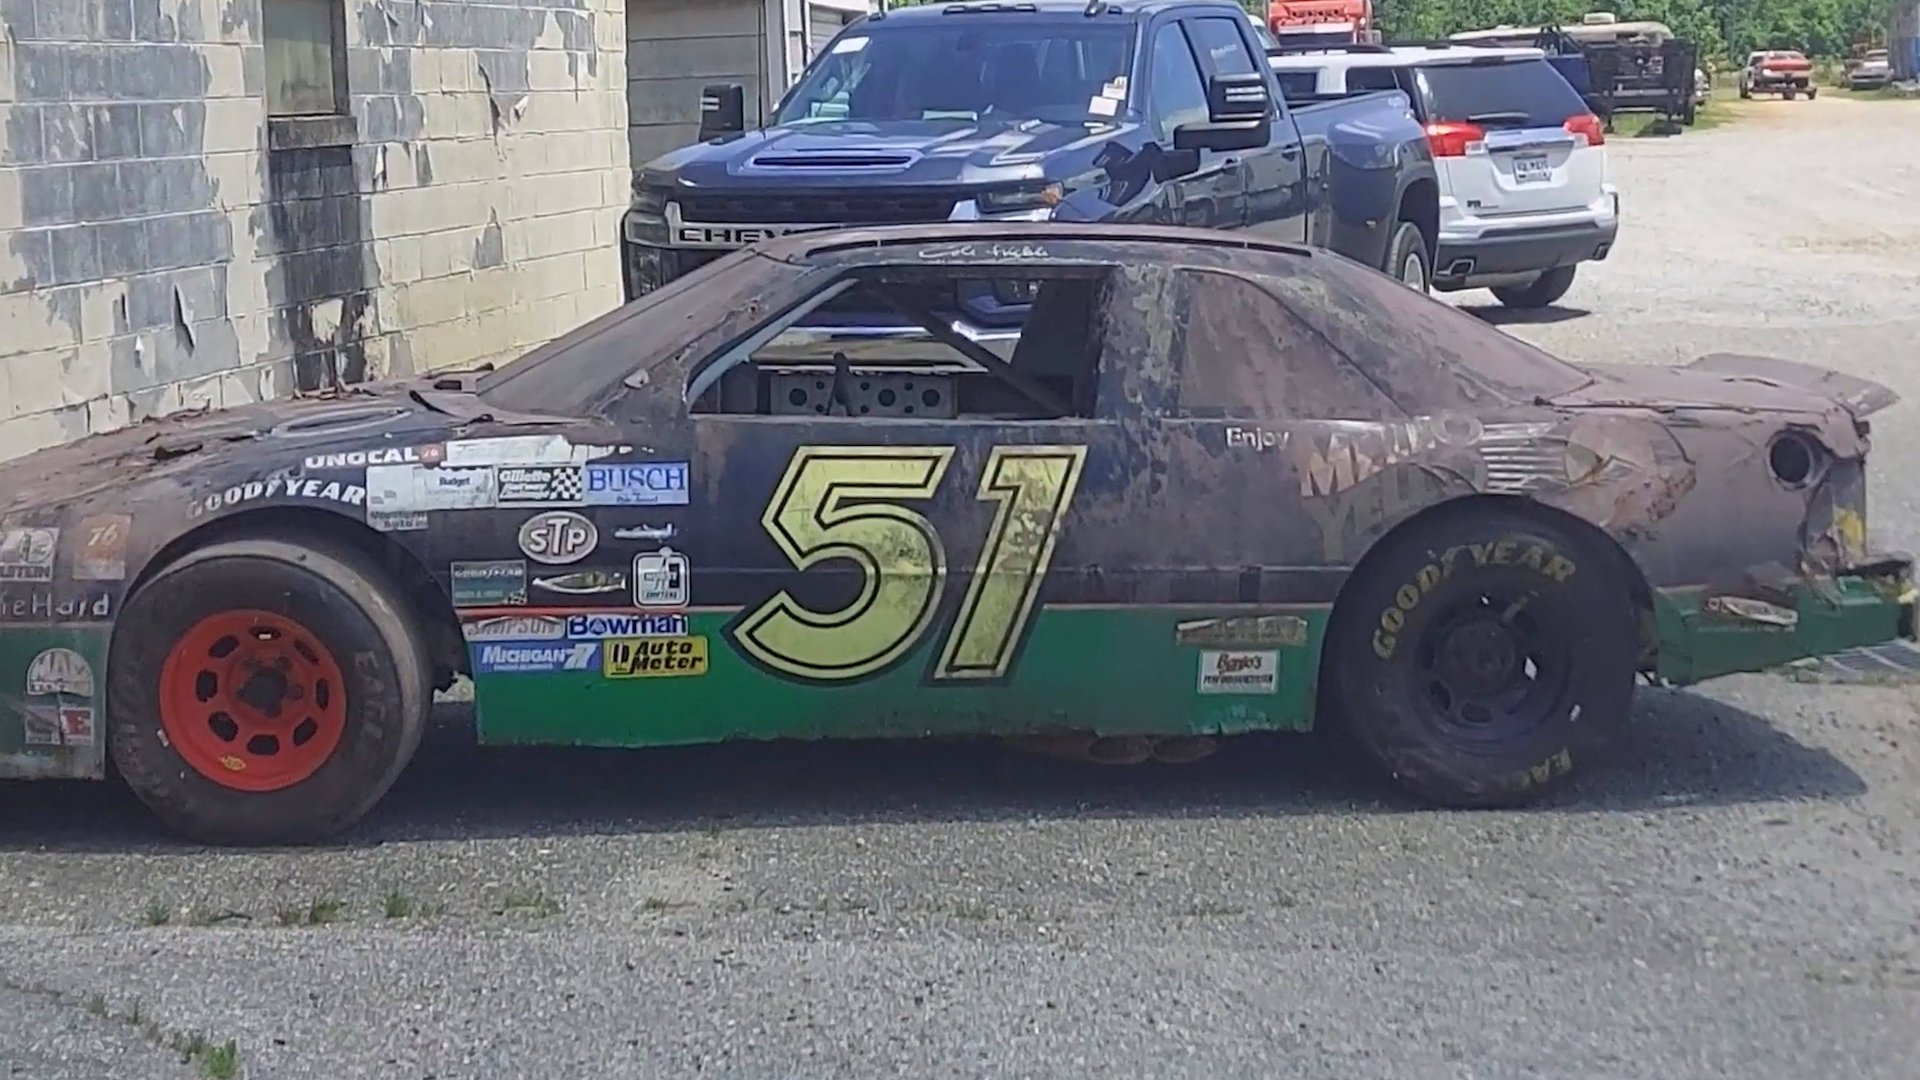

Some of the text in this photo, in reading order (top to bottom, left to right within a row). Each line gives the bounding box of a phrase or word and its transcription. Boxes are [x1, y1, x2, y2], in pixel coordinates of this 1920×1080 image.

[1226, 427, 1290, 452] Enjoy
[305, 446, 420, 469] UNOCAL
[438, 476, 471, 487] Budget
[499, 469, 552, 483] Gillette
[587, 467, 686, 491] BUSCH
[87, 523, 118, 546] 76
[528, 518, 587, 555] STP
[733, 445, 1088, 680] 51
[570, 614, 688, 637] Bowman
[635, 641, 693, 656] Auto
[632, 654, 704, 671] Meter
